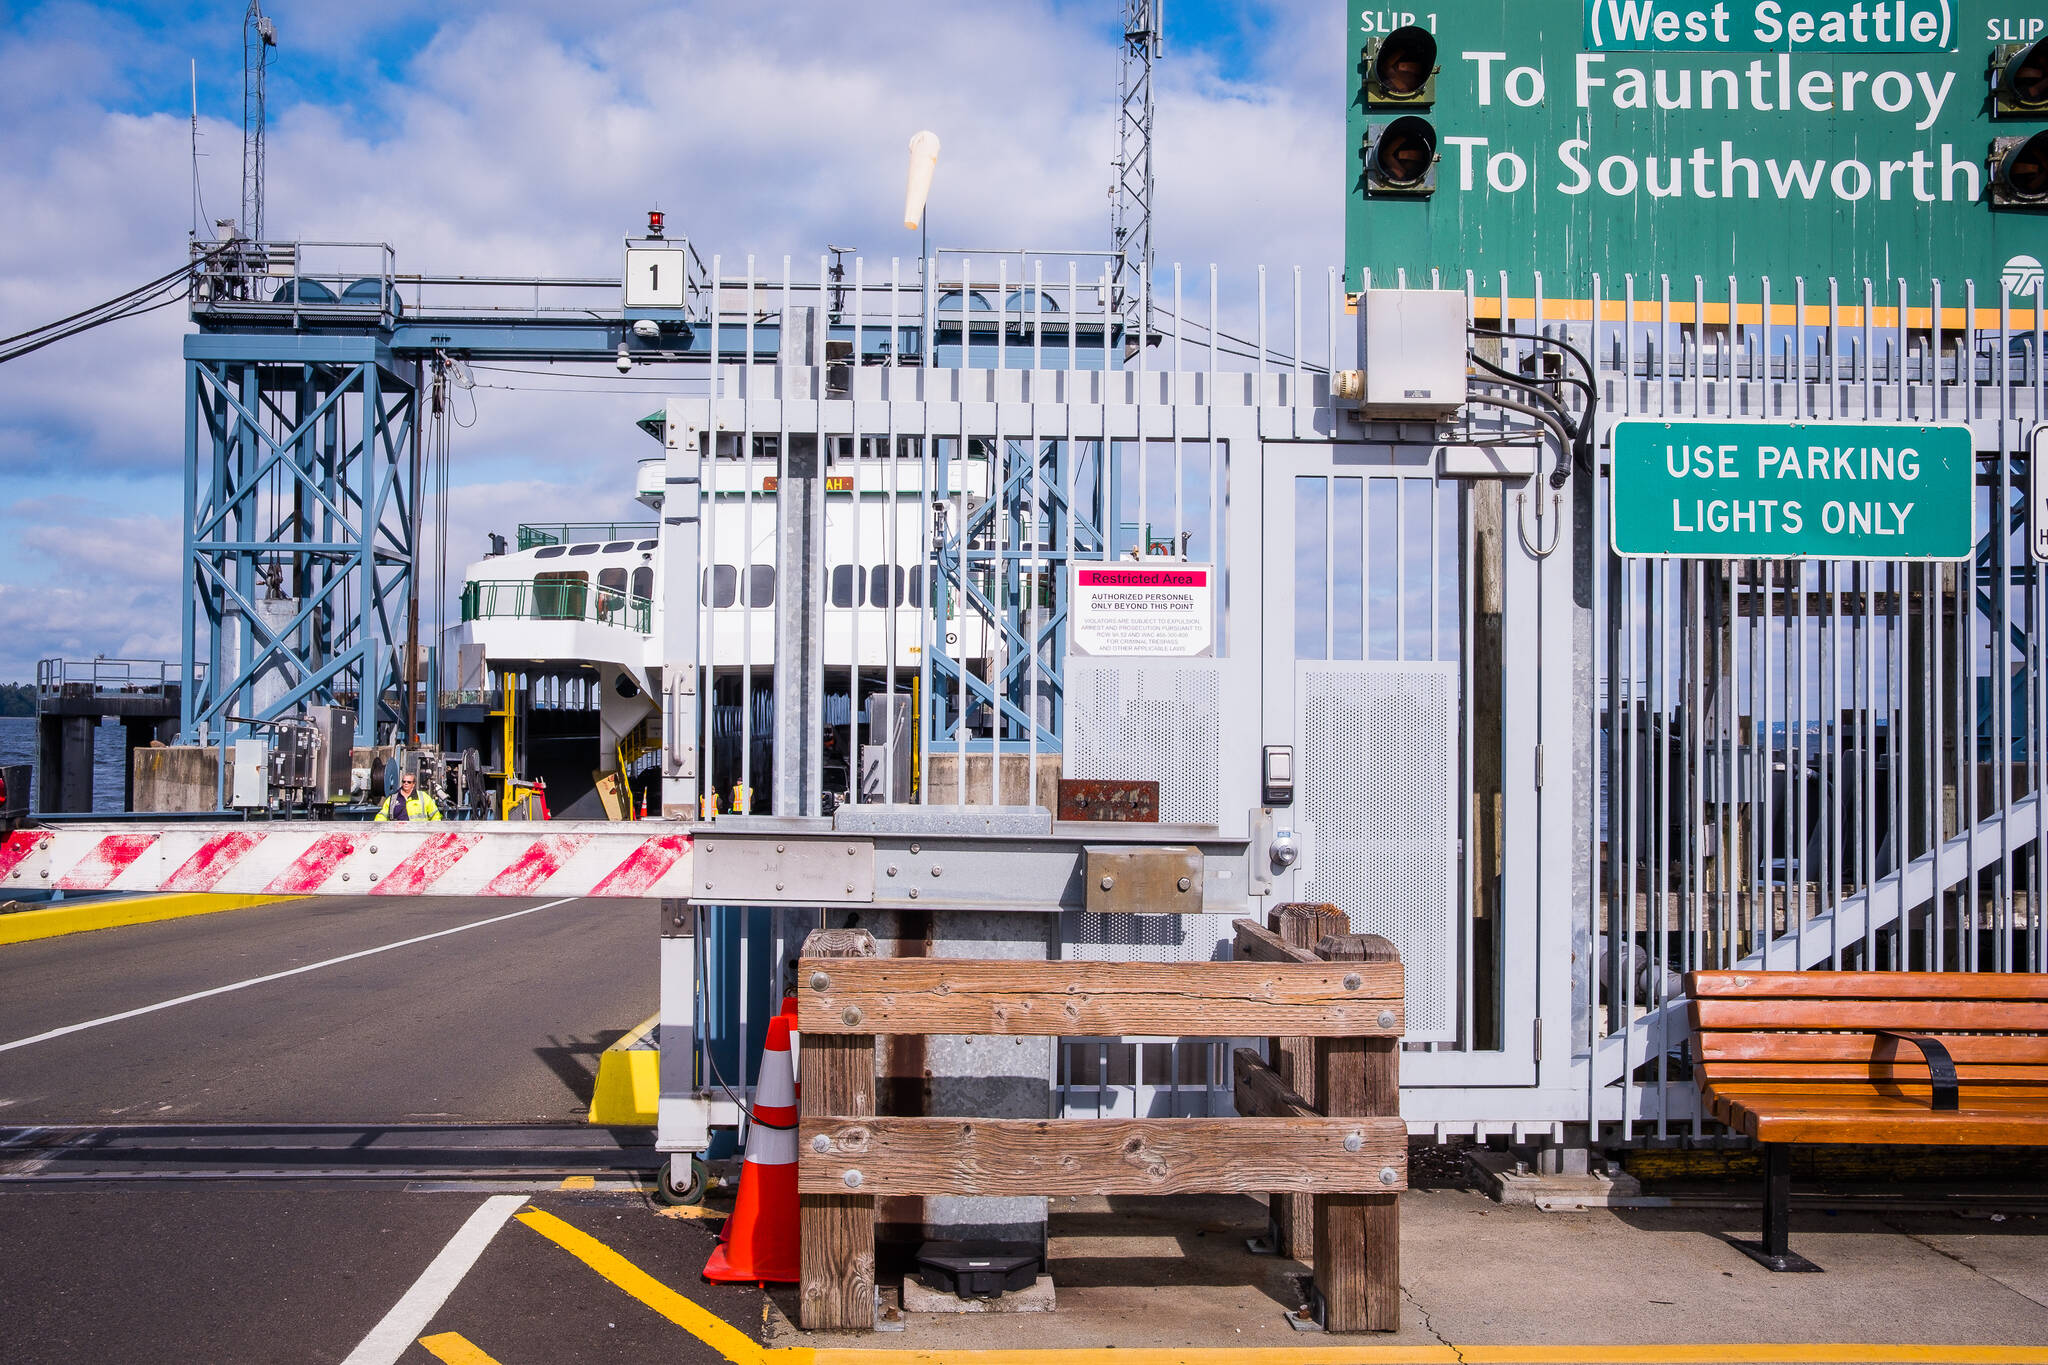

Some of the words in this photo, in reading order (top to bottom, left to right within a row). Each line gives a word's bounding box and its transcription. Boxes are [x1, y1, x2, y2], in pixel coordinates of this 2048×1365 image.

[1360, 11, 1416, 33] SLIP
[1427, 13, 1437, 35] 1
[1592, 0, 1730, 47] (West
[1754, 0, 1950, 48] Seattle)
[1987, 18, 2044, 41] SLIP
[1462, 51, 1545, 107] To
[1576, 53, 1956, 131] Fauntleroy
[1444, 136, 1527, 193] To
[1557, 140, 1980, 202] Southworth
[649, 264, 659, 291] 1
[1666, 445, 1740, 479] USE
[1758, 446, 1920, 481] PARKING
[1673, 498, 1803, 534] LIGHTS
[1821, 500, 1915, 535] ONLY
[1092, 572, 1159, 584] Restricted
[1162, 574, 1193, 585] Area
